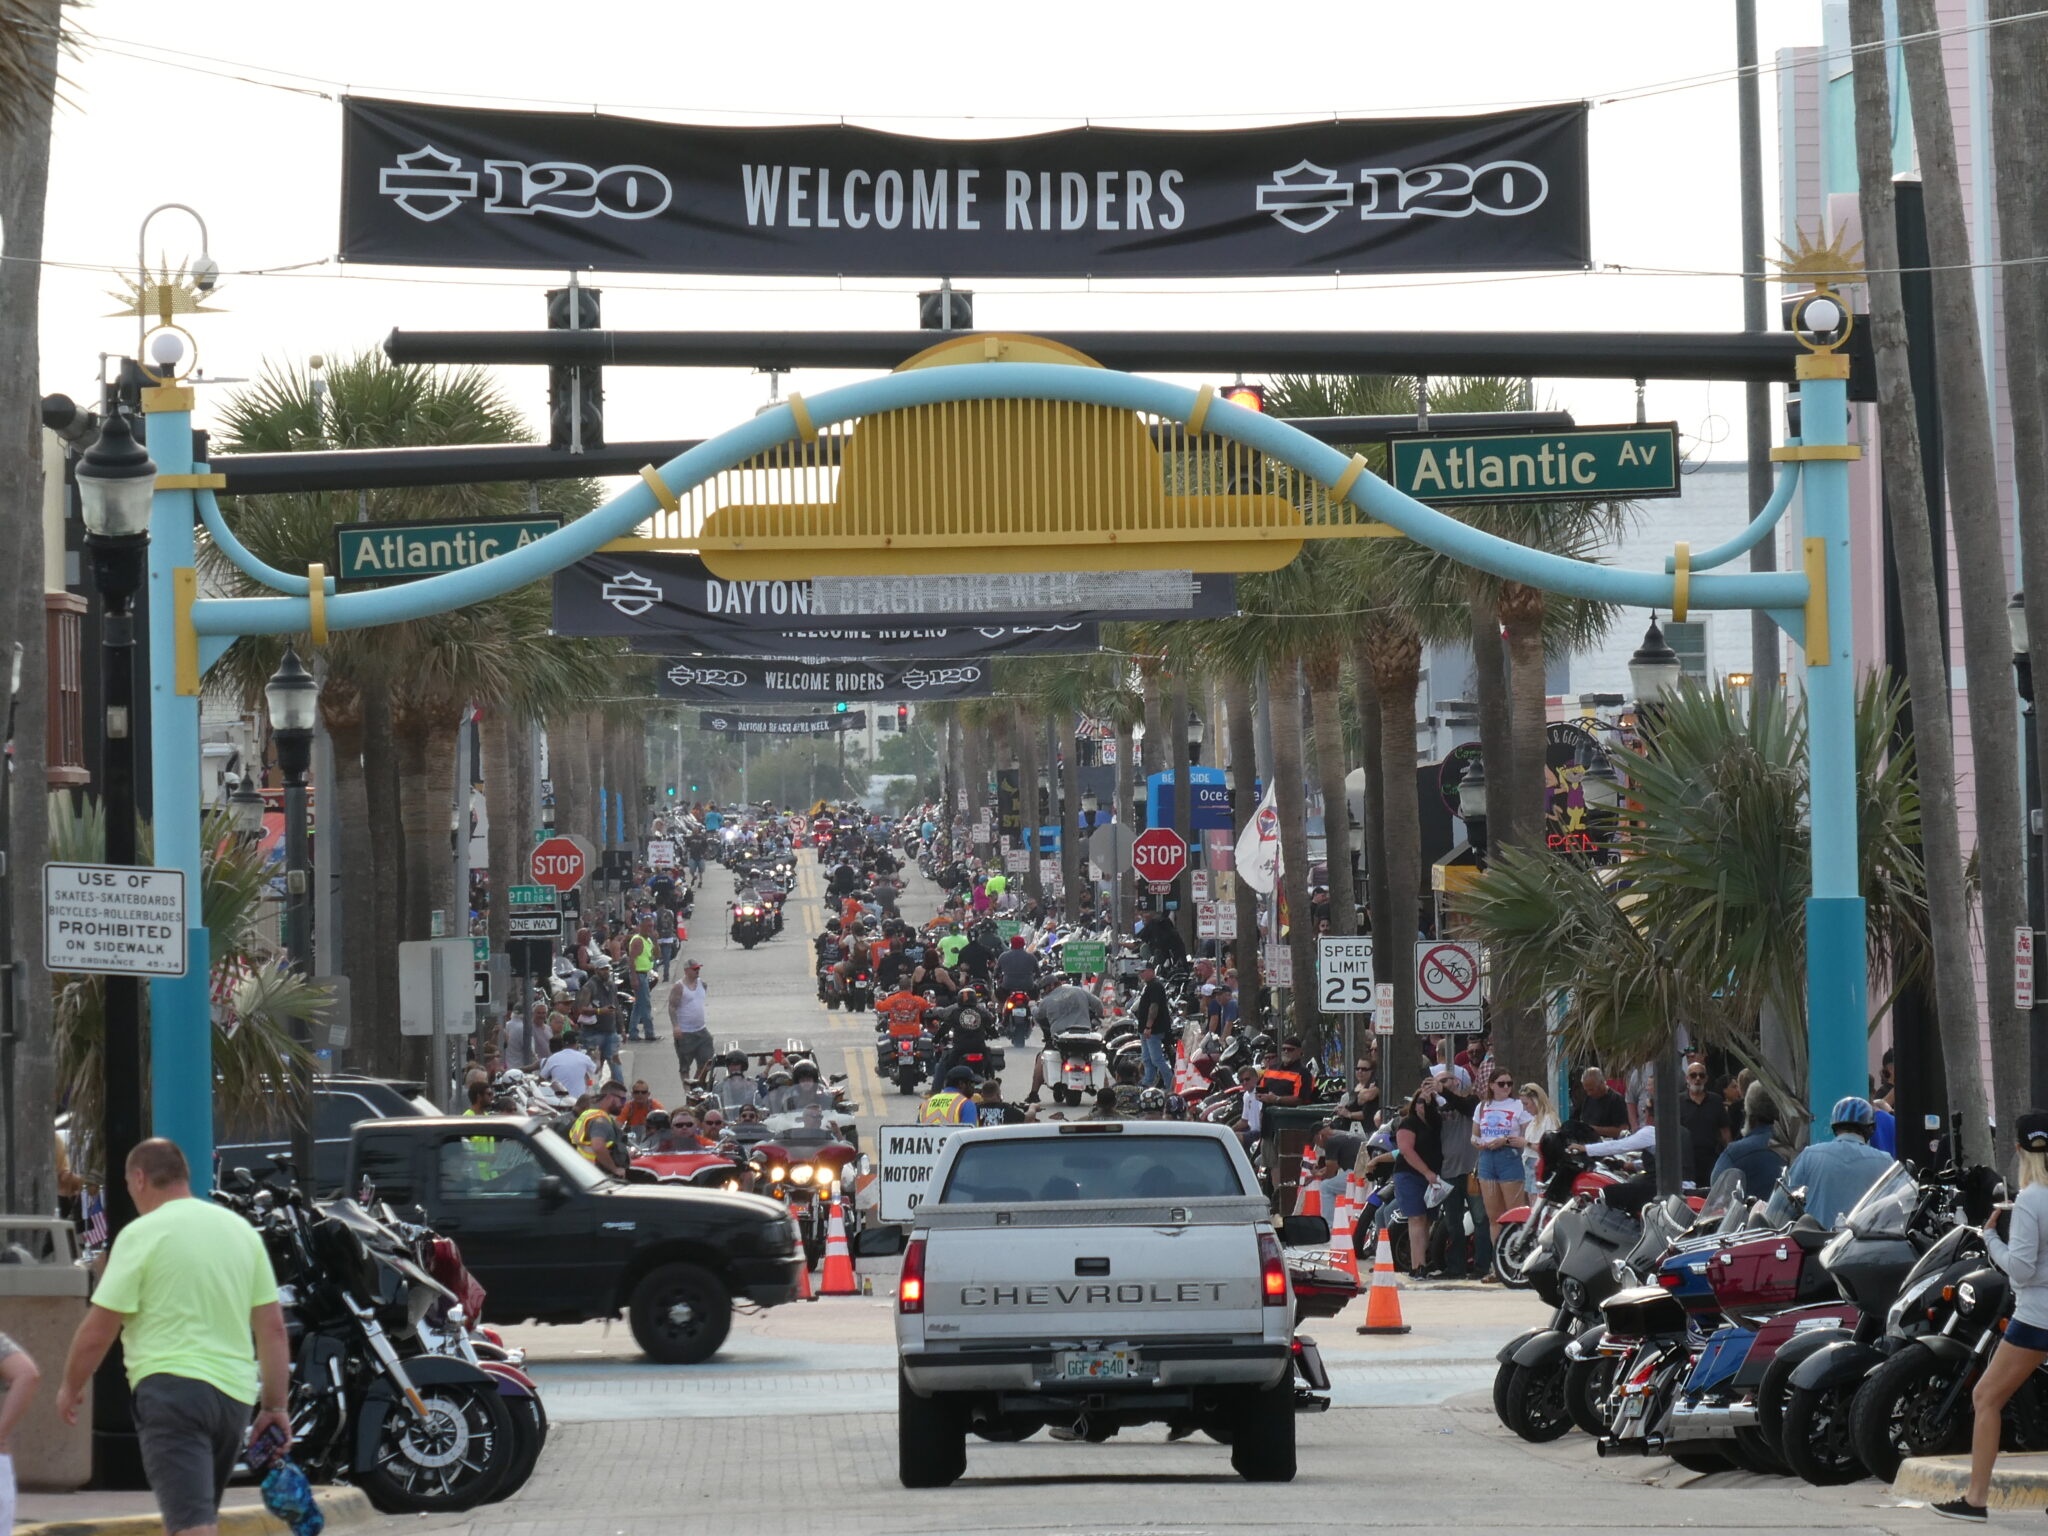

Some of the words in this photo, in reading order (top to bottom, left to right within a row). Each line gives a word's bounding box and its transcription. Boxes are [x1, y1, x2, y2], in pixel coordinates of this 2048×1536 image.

[485, 159, 673, 220] 120
[742, 164, 980, 231] WELCOME
[1004, 169, 1185, 231] RIDERS
[1361, 159, 1549, 221] 120
[1411, 441, 1597, 491] Atlantic
[1617, 440, 1657, 466] Av
[353, 530, 500, 571] Atlantic
[707, 579, 827, 615] DAYTONA
[840, 580, 925, 614] BEACH
[696, 669, 748, 687] 120
[765, 671, 830, 691] WELCOME
[835, 673, 885, 692] RIDERS
[930, 666, 981, 686] 120
[1200, 789, 1229, 801] Ocea
[1547, 833, 1599, 853] PEN
[1135, 845, 1182, 865] STOP
[534, 855, 581, 875] STOP
[78, 872, 117, 886] USE
[128, 875, 152, 888] OF
[55, 890, 176, 906] SKATES-SKATEBOARDS
[509, 891, 531, 903] ern
[49, 906, 182, 922] BICYCLES-ROLLERBLADES
[59, 921, 172, 939] PROHIBITED
[510, 919, 530, 930] ONE
[533, 919, 554, 929] WAY
[66, 940, 85, 950] ON
[94, 941, 165, 954] SIDEWALK
[1325, 945, 1373, 957] SPEED
[1330, 961, 1368, 974] LIMIT
[1326, 977, 1371, 1004] 25
[1376, 999, 1393, 1007] PARKIN
[1424, 1021, 1475, 1029] SIDEWALK
[1443, 1012, 1456, 1020] ON
[889, 1137, 934, 1154] MAIN
[937, 1137, 947, 1153] S
[960, 1282, 1228, 1307] CHEVROLET
